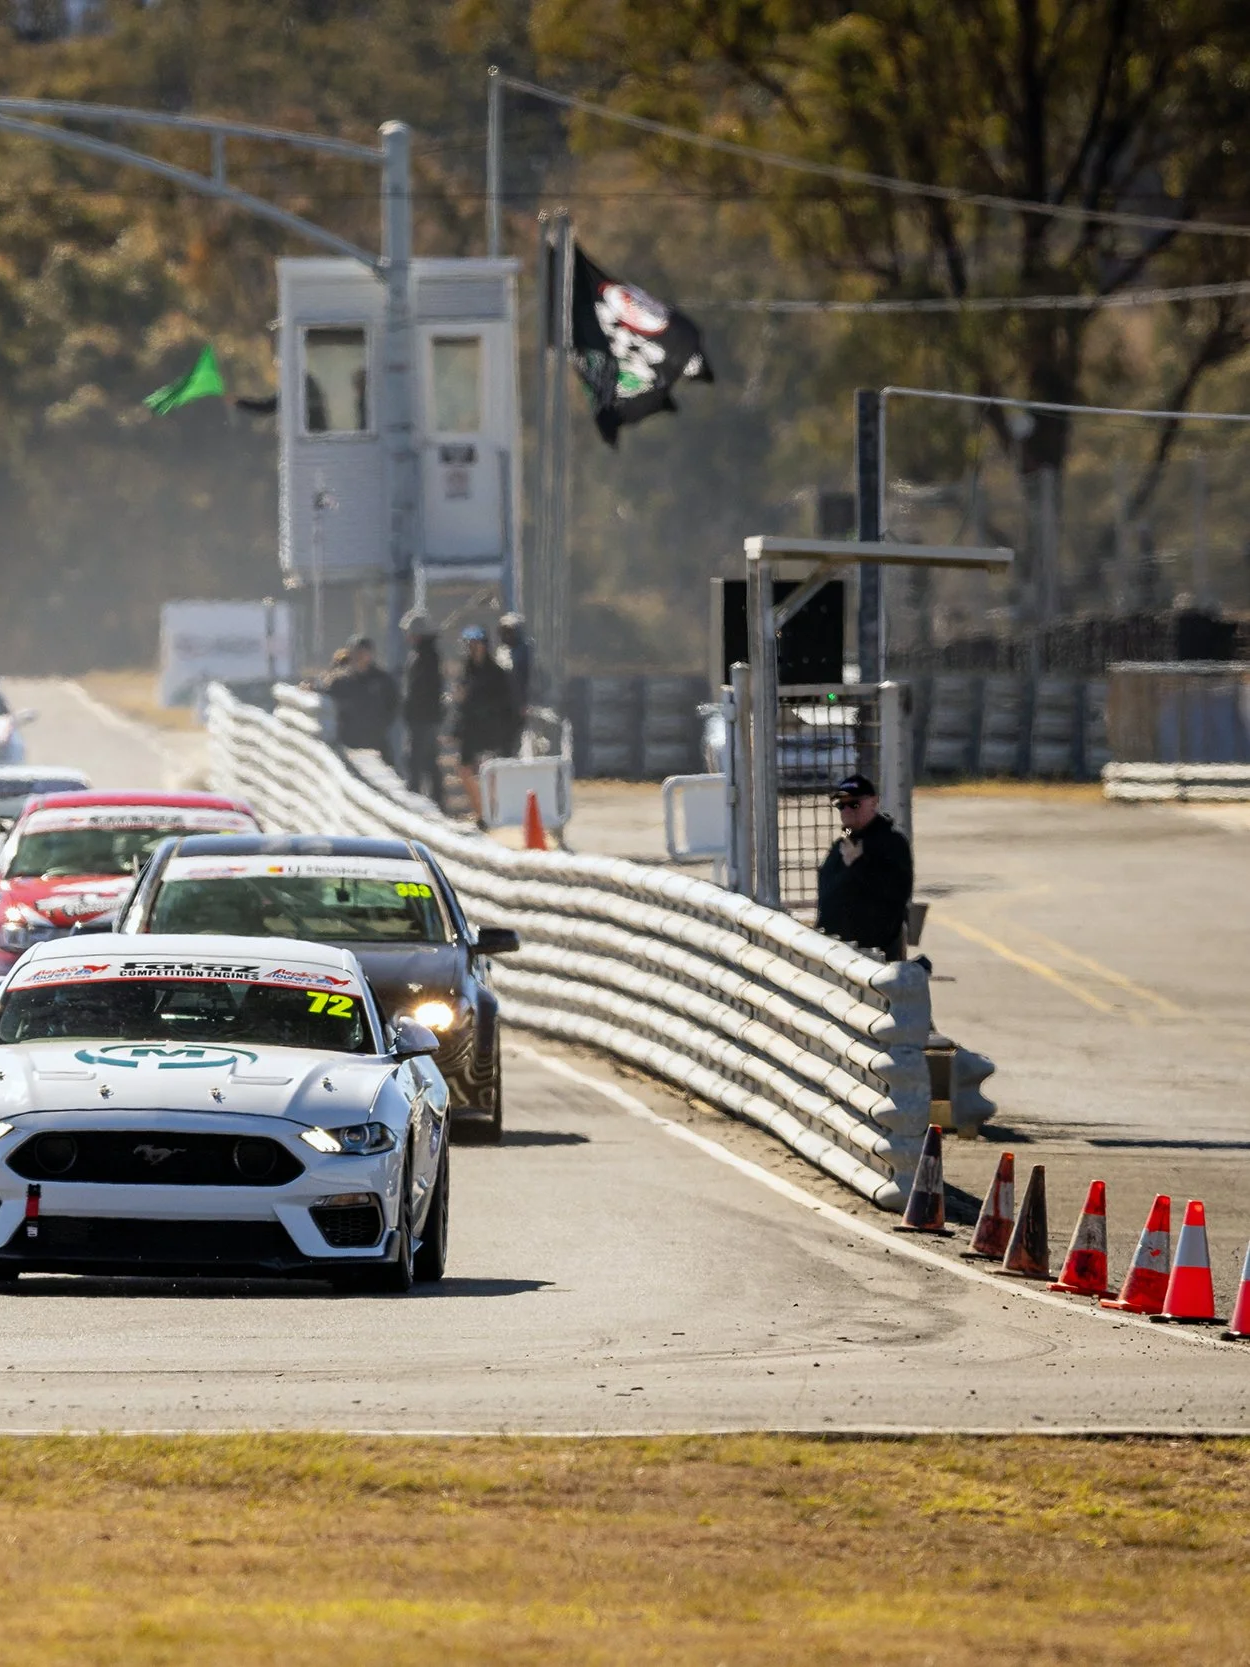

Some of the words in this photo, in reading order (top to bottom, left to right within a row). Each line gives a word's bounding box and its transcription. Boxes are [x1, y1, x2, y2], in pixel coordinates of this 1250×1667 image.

[119, 969, 204, 978] COMPETITION
[207, 971, 260, 981] ENGINES
[306, 991, 354, 1018] 72
